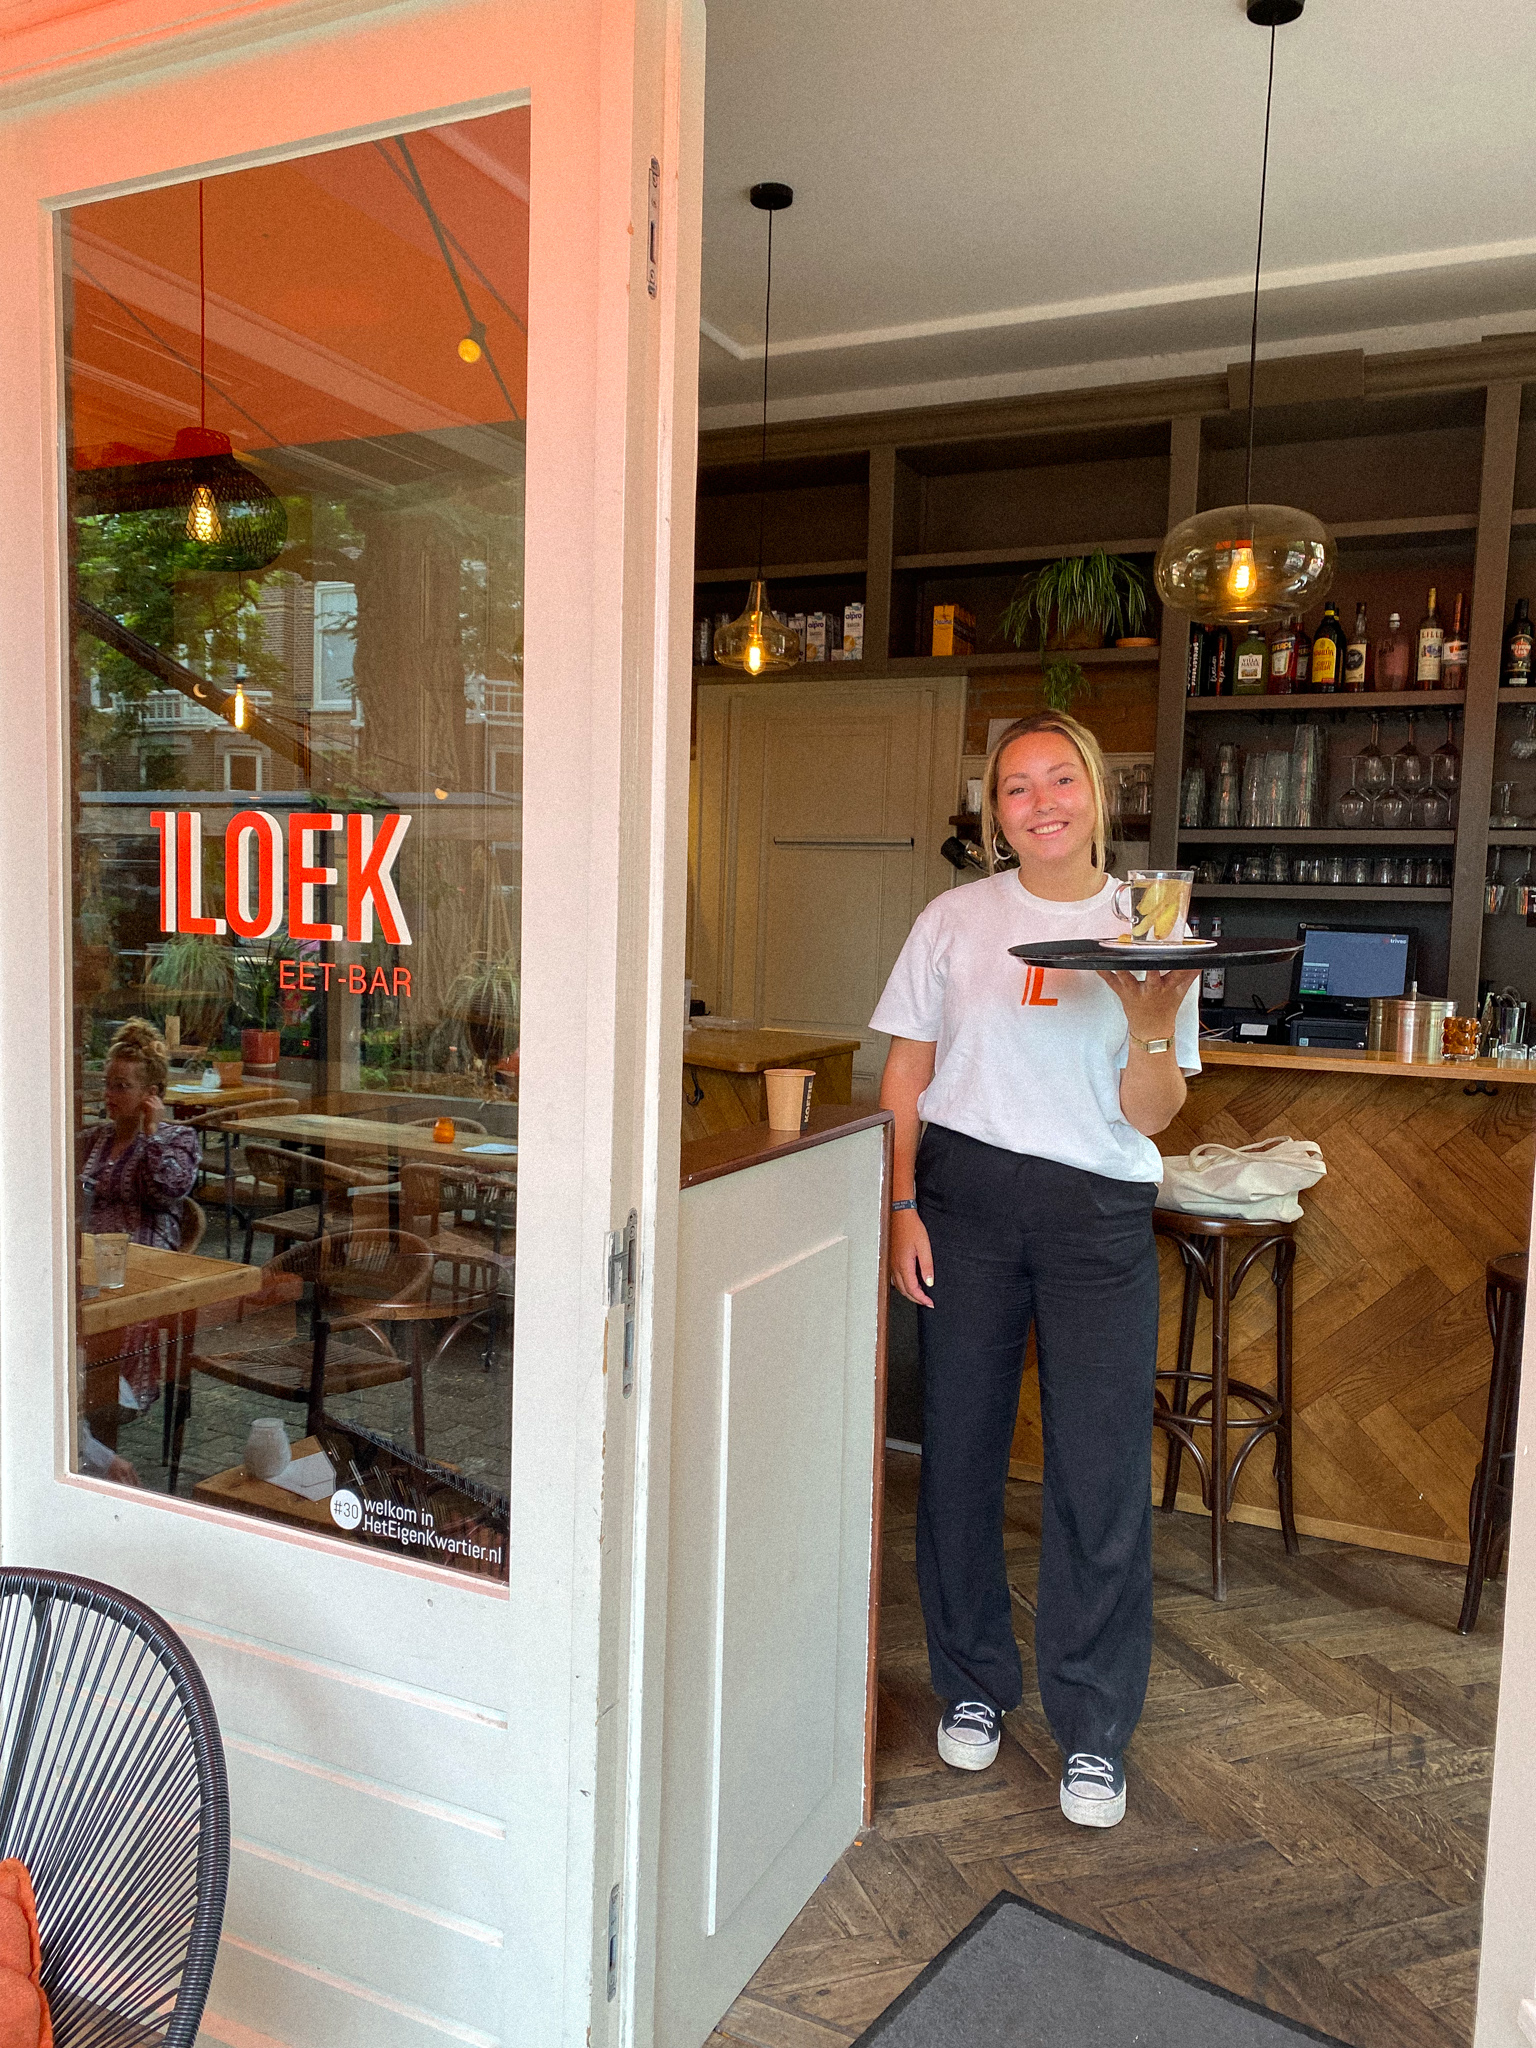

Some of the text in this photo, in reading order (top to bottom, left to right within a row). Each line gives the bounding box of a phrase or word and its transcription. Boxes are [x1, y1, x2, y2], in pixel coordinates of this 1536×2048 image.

[807, 620, 825, 630] alpro
[845, 611, 863, 621] alpro
[279, 960, 412, 998] EET-BAR
[333, 1499, 359, 1520] #30
[363, 1498, 434, 1527] welkom in
